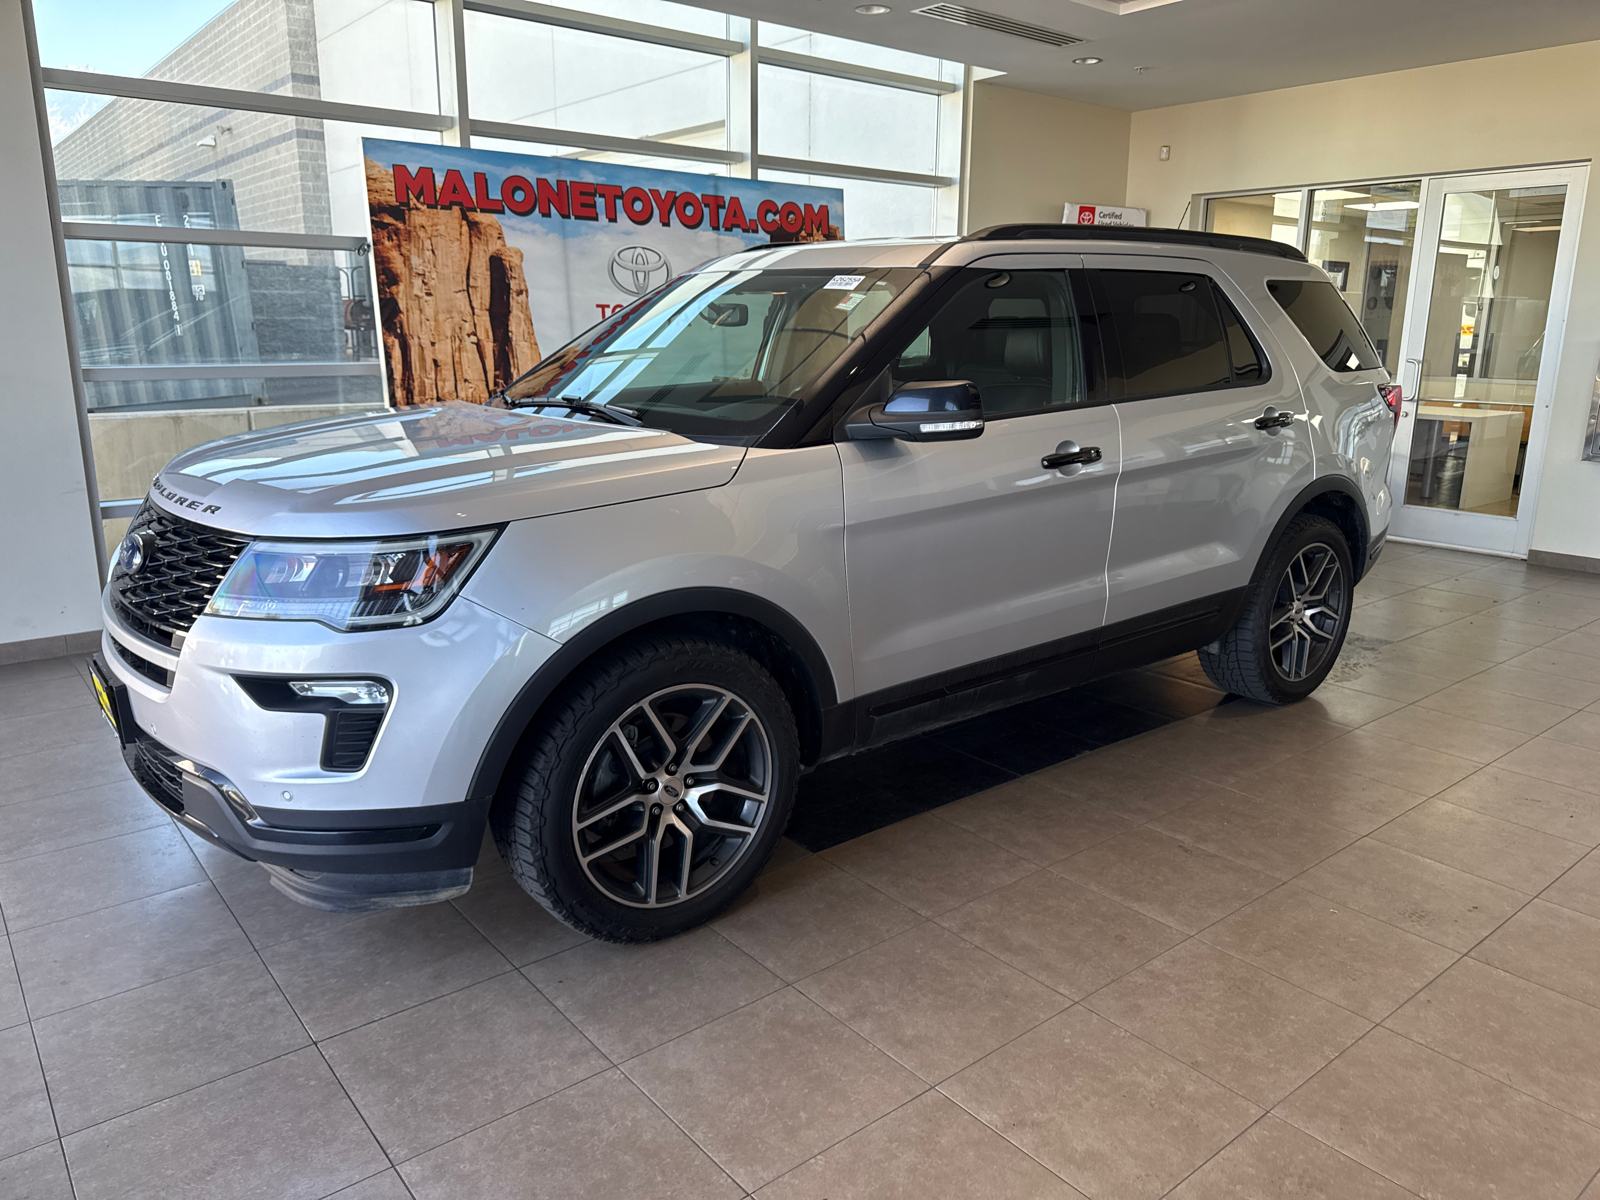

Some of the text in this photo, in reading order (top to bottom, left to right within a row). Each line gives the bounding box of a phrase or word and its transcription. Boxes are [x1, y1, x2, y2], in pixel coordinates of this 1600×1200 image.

[392, 164, 829, 235] MALONETOYOTA.COM
[1098, 211, 1122, 220] Certified
[153, 473, 222, 515] PLORER
